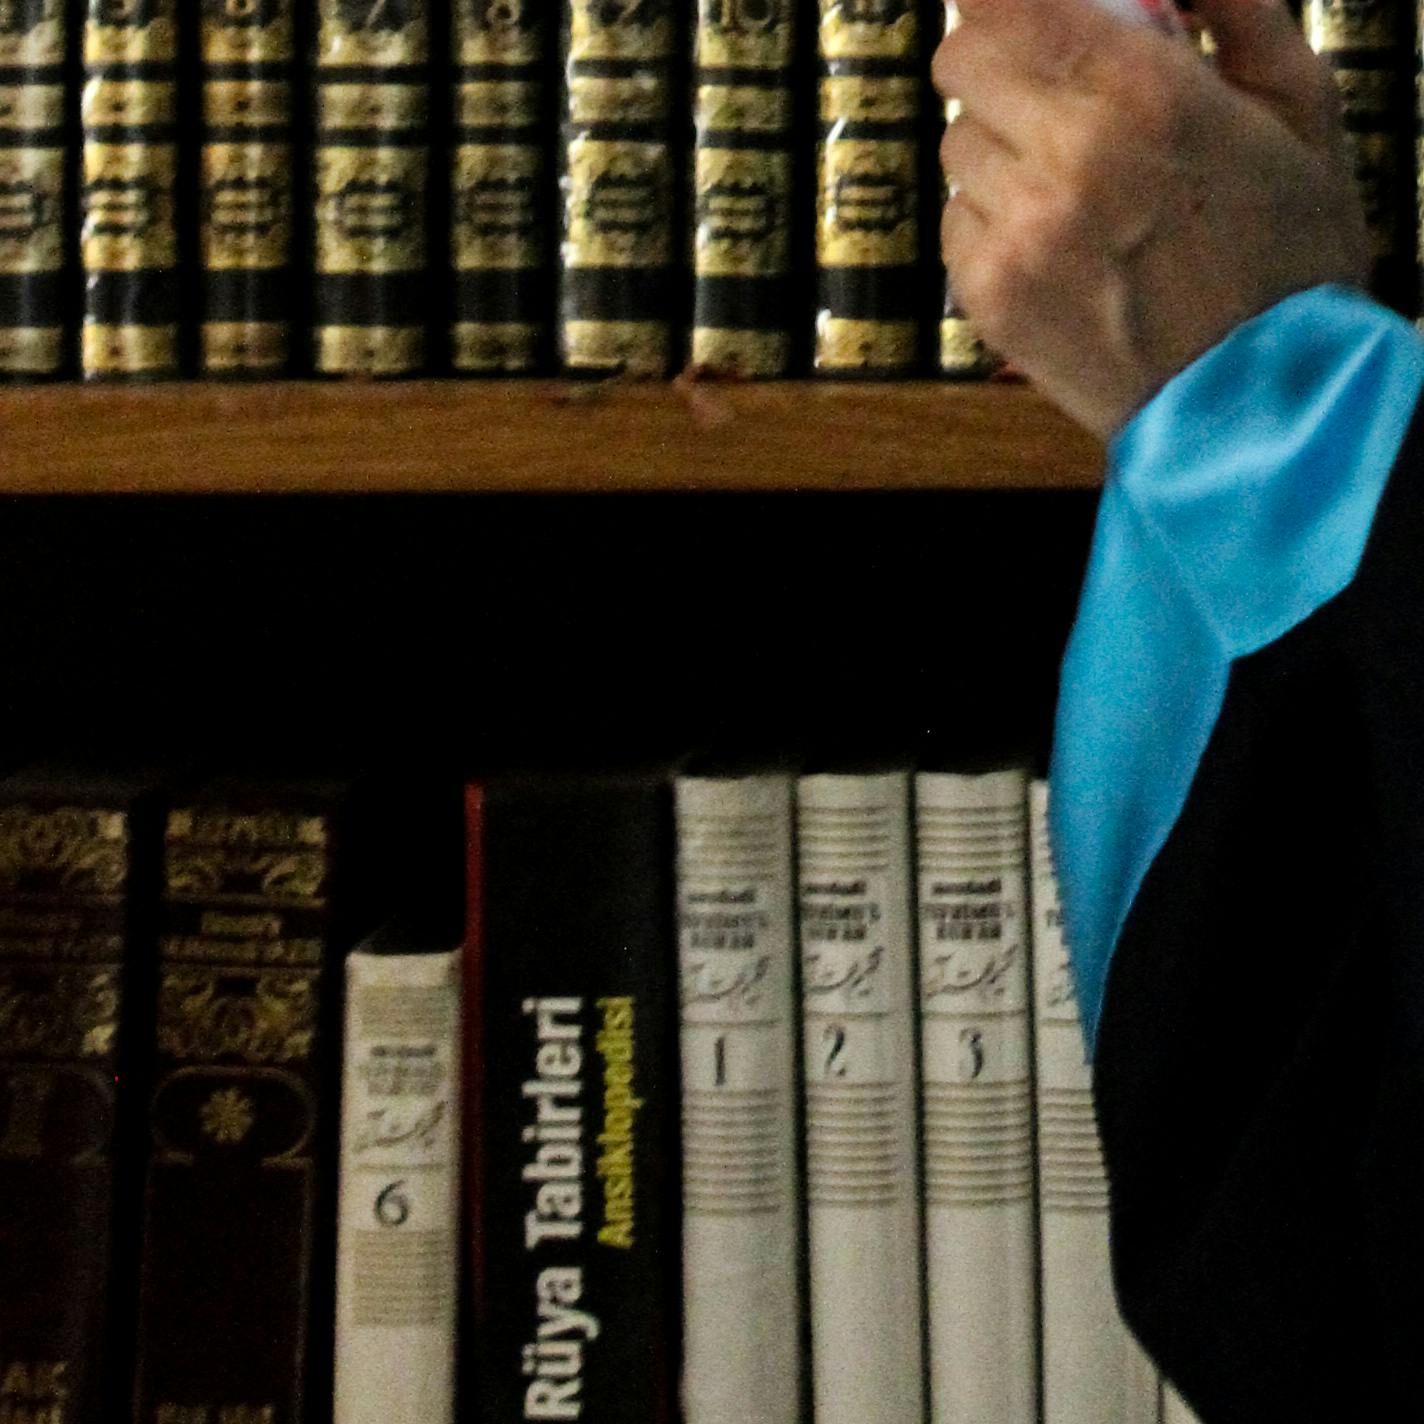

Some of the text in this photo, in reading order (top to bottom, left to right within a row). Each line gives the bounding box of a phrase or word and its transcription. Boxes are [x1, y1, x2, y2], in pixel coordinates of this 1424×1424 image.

[373, 1178, 409, 1227] 6
[523, 995, 600, 1421] Rüya Tabirleri
